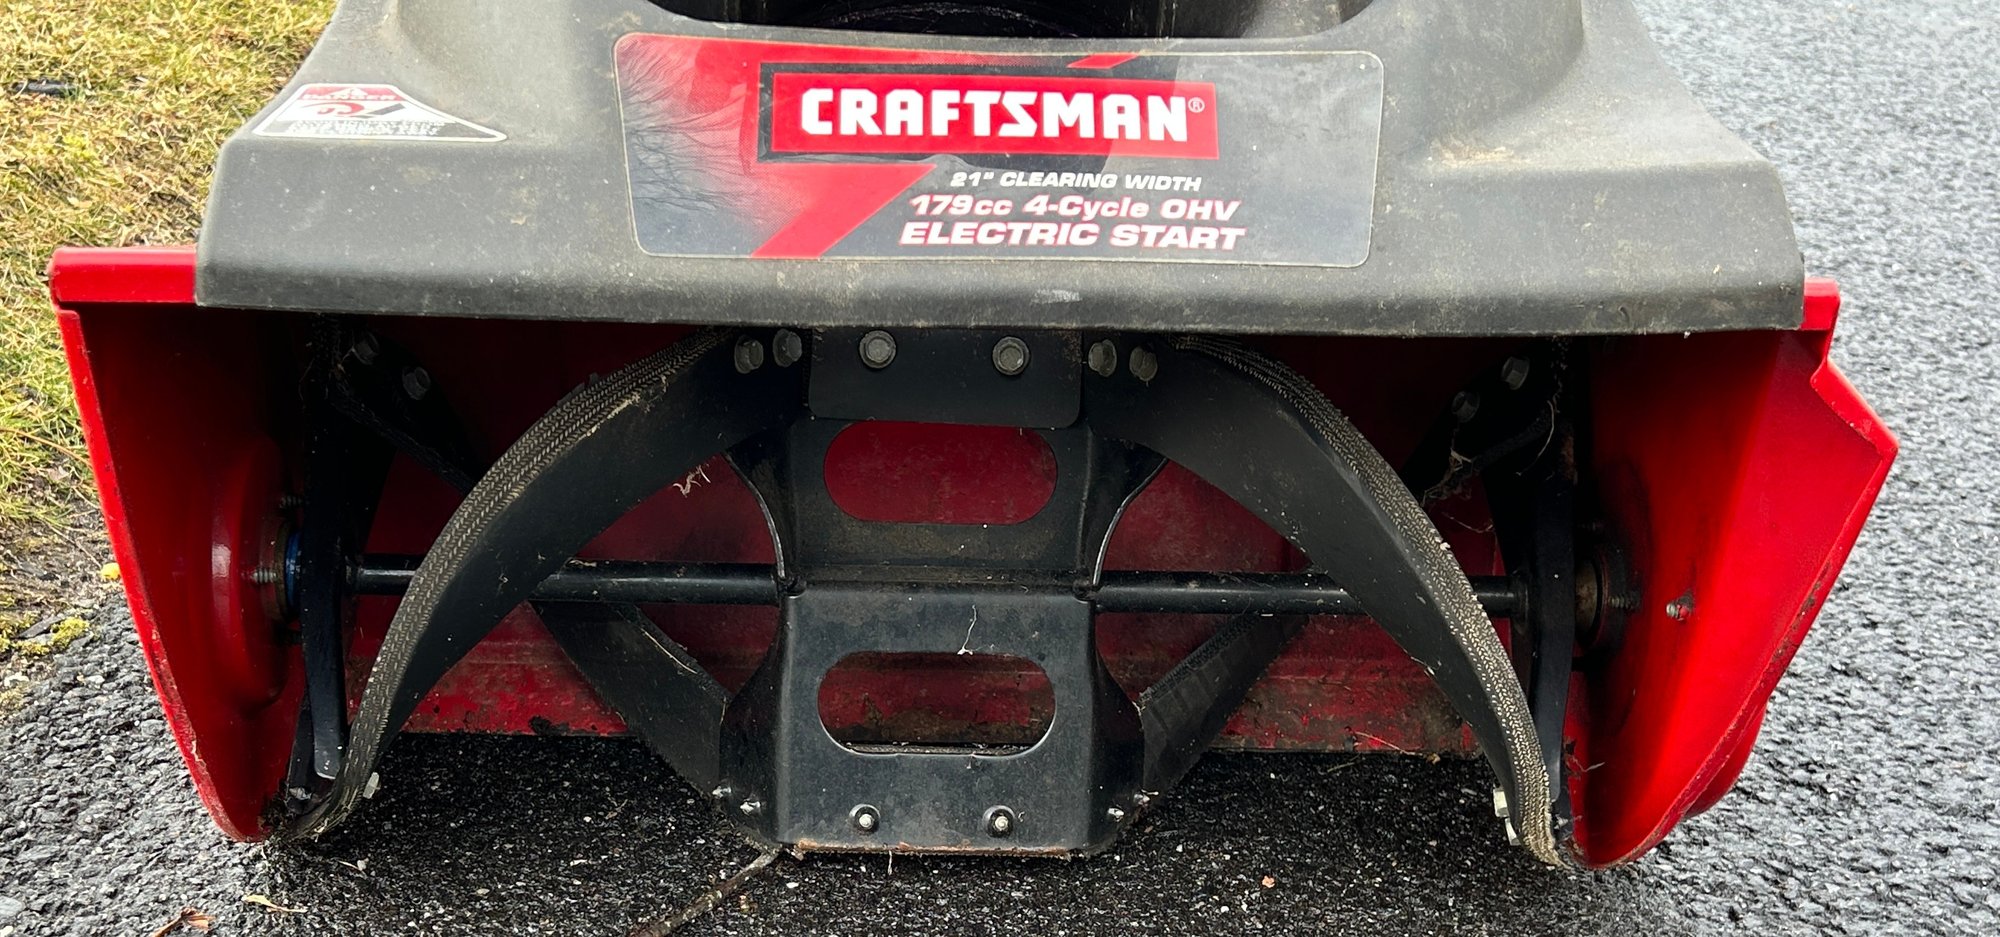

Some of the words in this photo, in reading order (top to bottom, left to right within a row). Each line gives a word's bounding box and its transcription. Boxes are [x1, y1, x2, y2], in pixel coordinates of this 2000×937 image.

[999, 172, 1117, 189] CLEARING
[1124, 174, 1202, 192] WIDTH
[909, 195, 1012, 216] 179cc
[1023, 196, 1149, 219] 4-Cycle
[1160, 198, 1240, 221] OHV
[899, 221, 1098, 246] ELECTRIC
[1110, 224, 1246, 249] START
